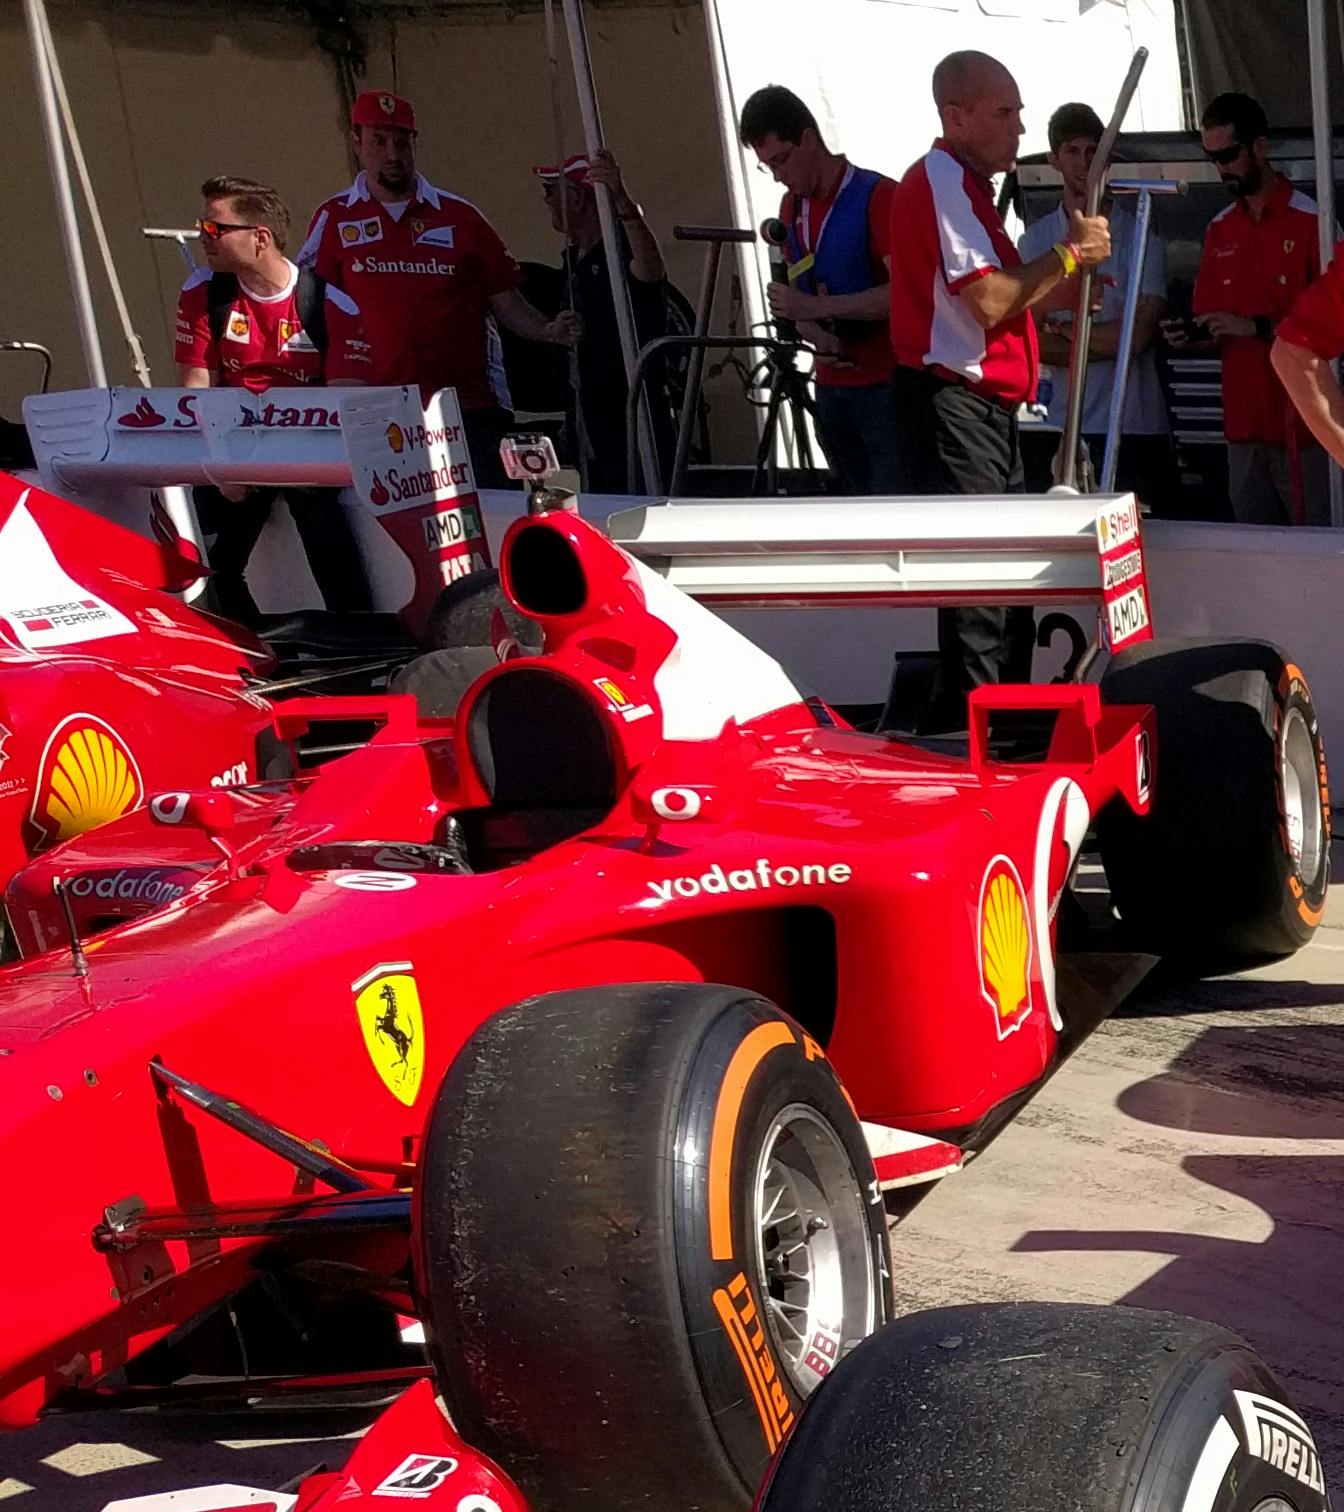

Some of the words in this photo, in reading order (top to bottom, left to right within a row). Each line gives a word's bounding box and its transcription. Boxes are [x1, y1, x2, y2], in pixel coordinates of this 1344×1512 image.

[366, 256, 456, 276] Santander
[404, 424, 460, 450] V-Power
[387, 454, 468, 502] Santander
[426, 513, 461, 547] AMD
[1110, 503, 1138, 540] Shell
[10, 602, 81, 619] SCUDERIA
[51, 610, 112, 627] FERRARI
[1113, 596, 1140, 640] AMD
[648, 859, 852, 900] vodafone
[1233, 1389, 1326, 1497] PIRELLI
